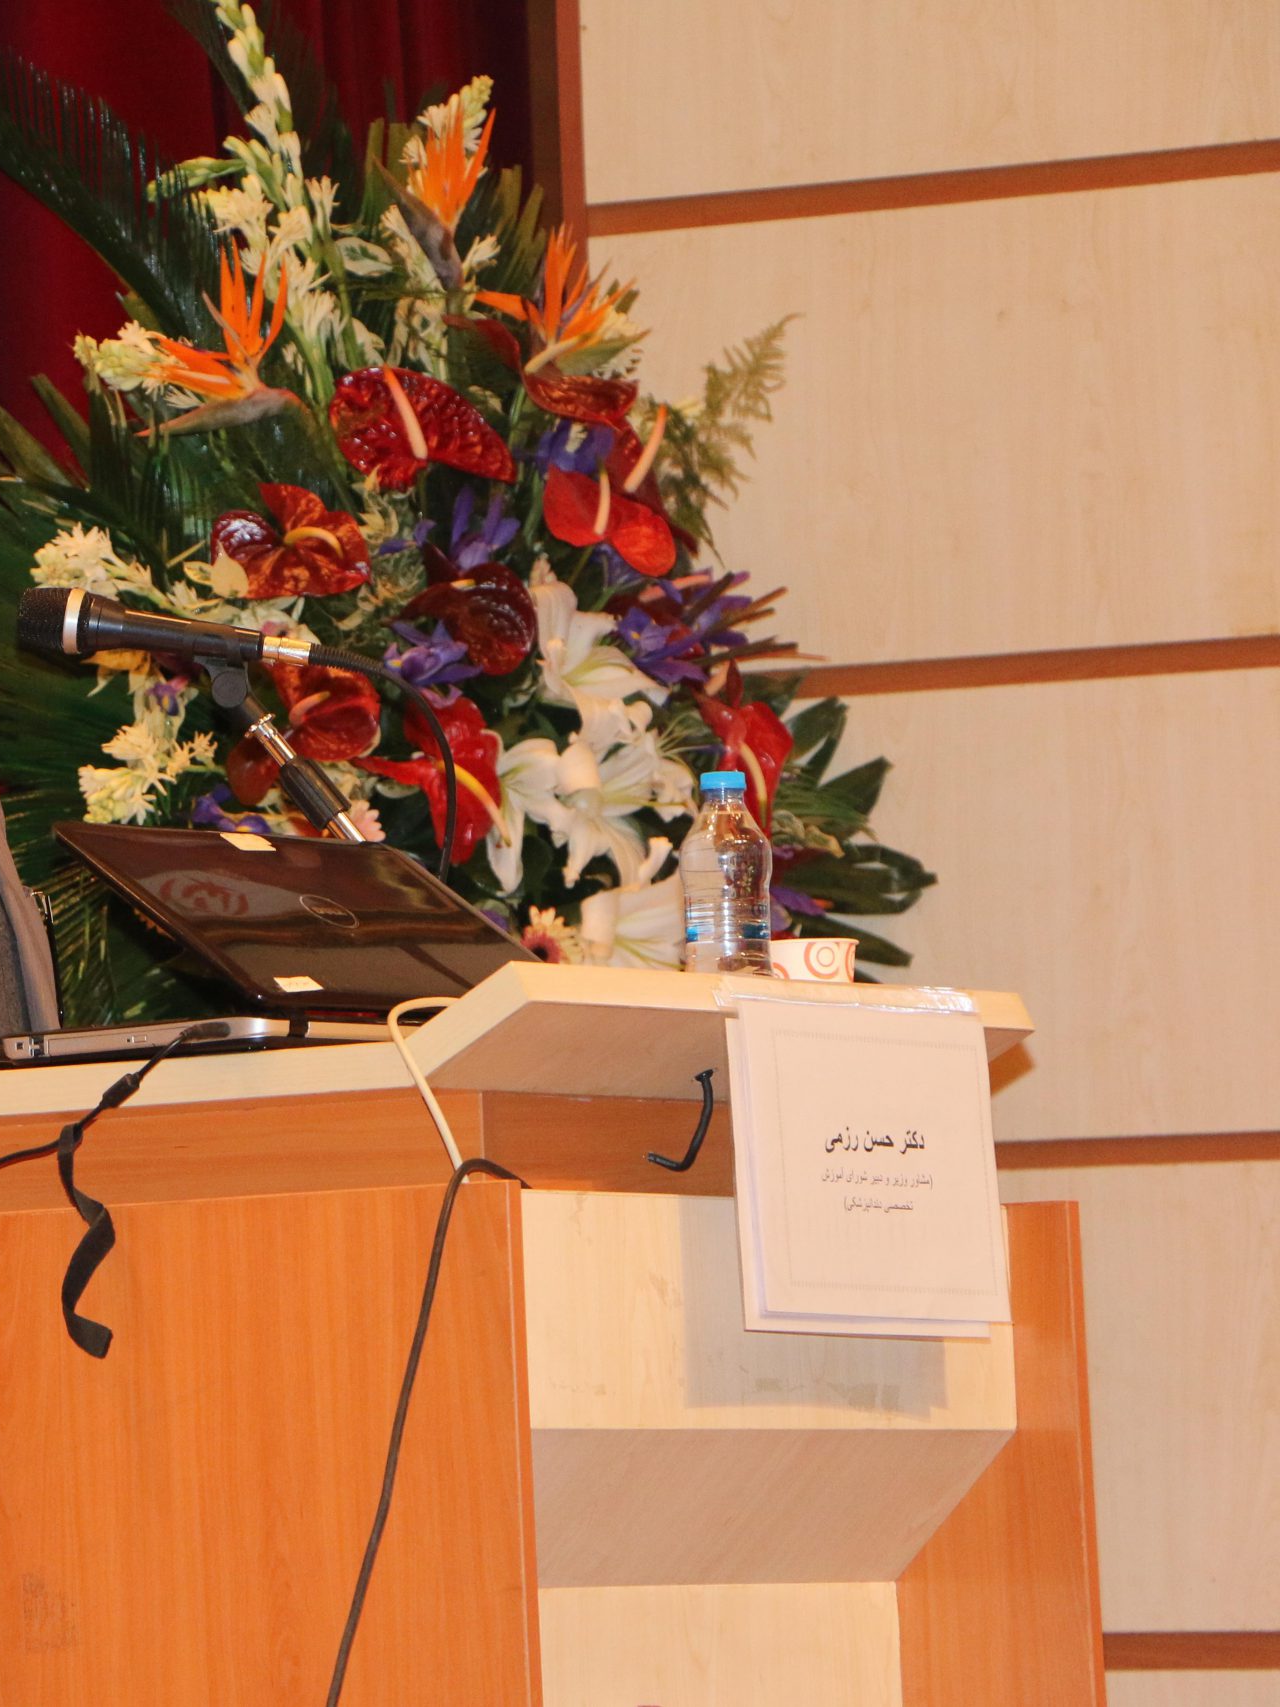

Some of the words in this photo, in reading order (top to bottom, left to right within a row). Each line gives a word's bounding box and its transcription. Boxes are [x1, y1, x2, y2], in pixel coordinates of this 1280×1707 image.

[825, 1126, 859, 1153] رزمی
[863, 1130, 894, 1152] حسن
[900, 1130, 925, 1154] دکتر
